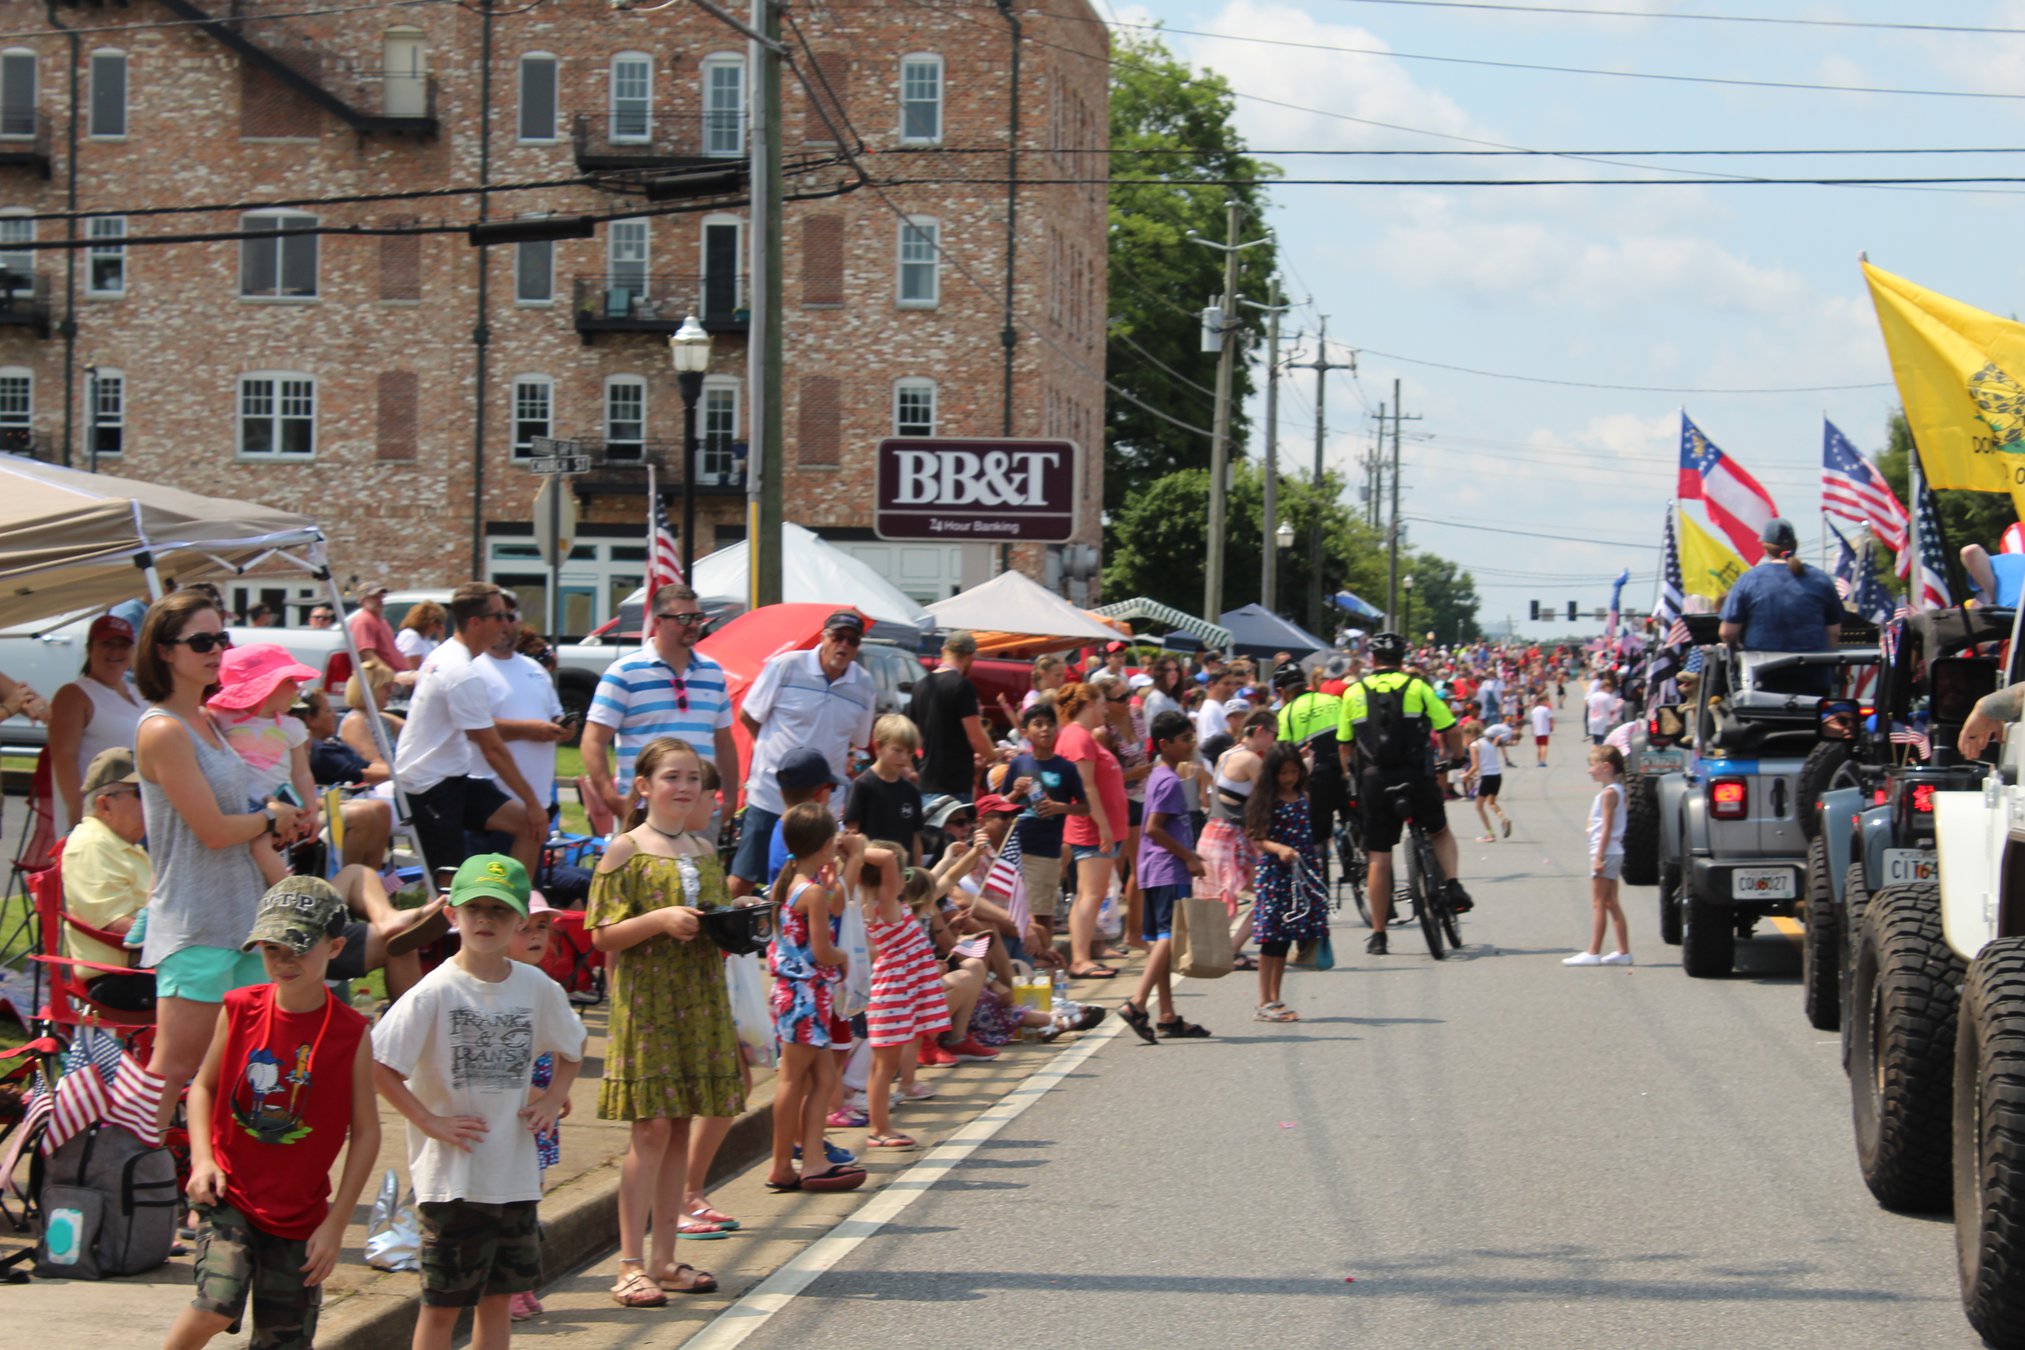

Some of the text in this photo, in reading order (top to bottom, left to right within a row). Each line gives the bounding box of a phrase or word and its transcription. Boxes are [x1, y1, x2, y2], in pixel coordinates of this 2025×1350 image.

[892, 450, 1059, 506] BB&T
[929, 518, 1019, 534] 24 Hour Banking
[448, 1009, 526, 1035] FRANK
[476, 1031, 493, 1048] &
